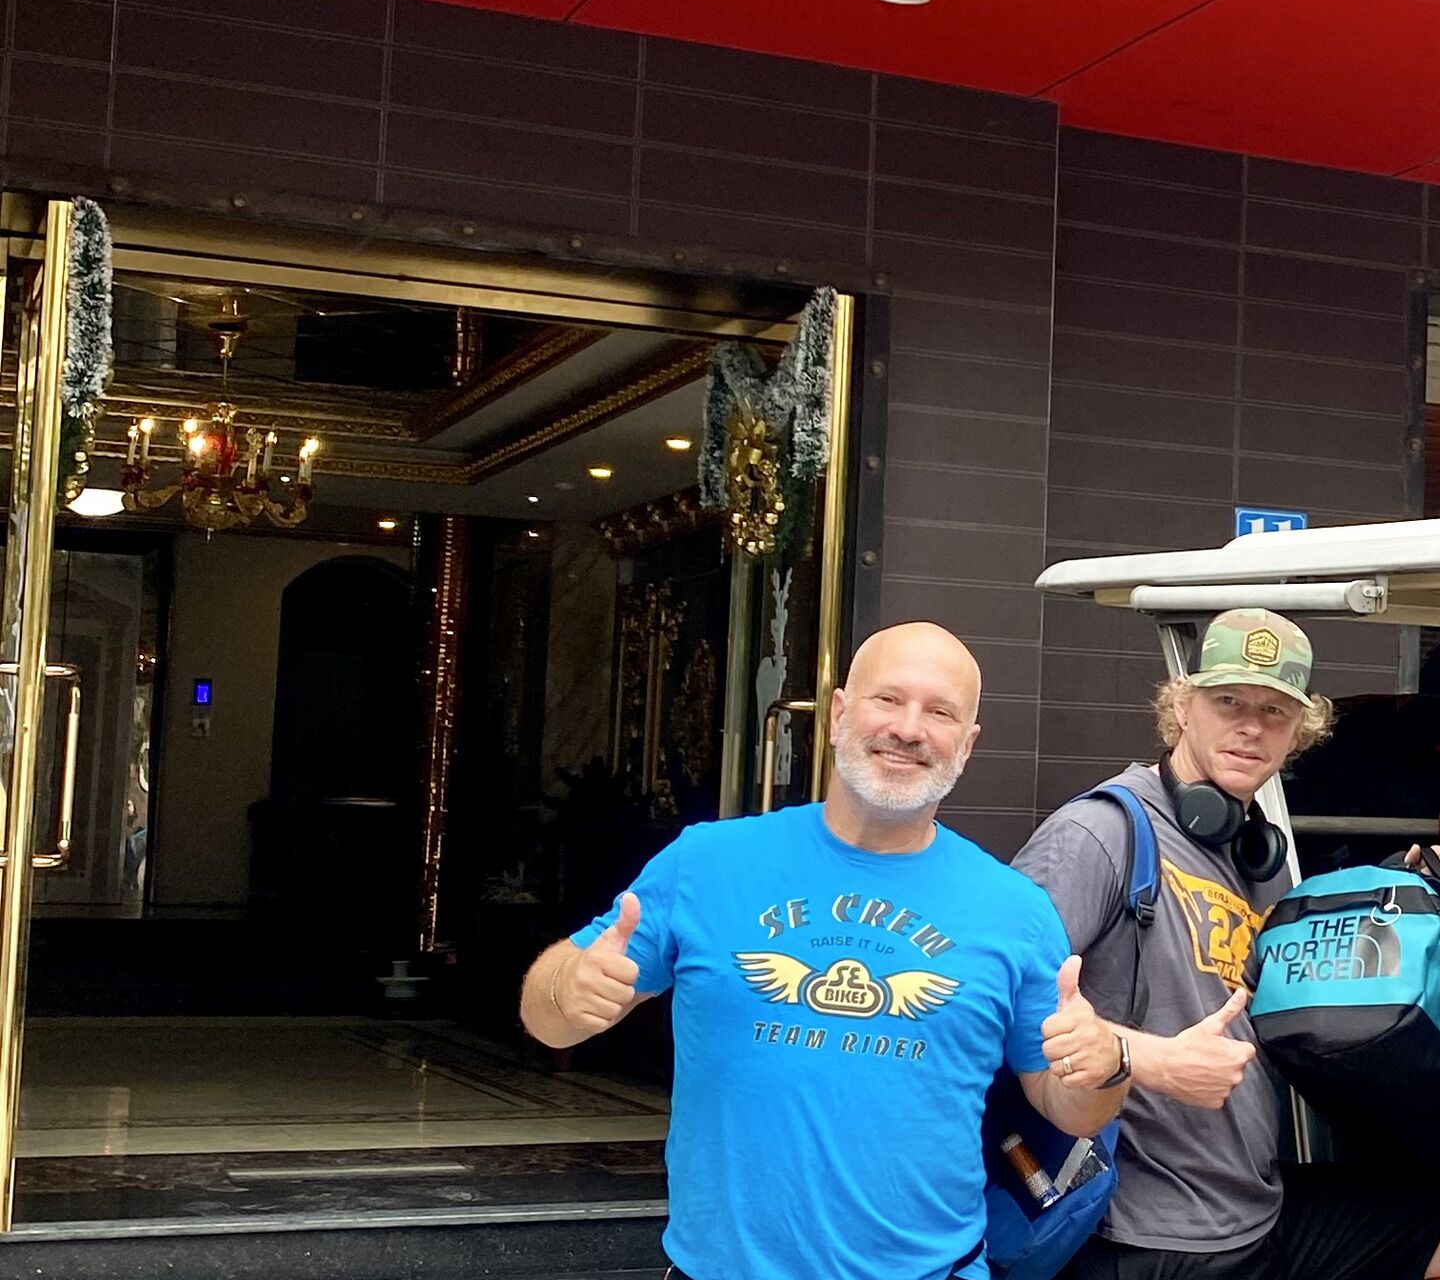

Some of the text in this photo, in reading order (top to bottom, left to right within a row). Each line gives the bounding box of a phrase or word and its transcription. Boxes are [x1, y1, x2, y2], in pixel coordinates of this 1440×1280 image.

[759, 893, 957, 959] SE CREW
[1308, 916, 1357, 939] THE
[810, 936, 895, 956] RAISE IT UP
[1262, 938, 1353, 964] NORTH
[828, 965, 865, 989] SE
[1286, 959, 1350, 984] FACE
[824, 988, 867, 1005] BIKES
[754, 1022, 928, 1061] TEAM RIDER
